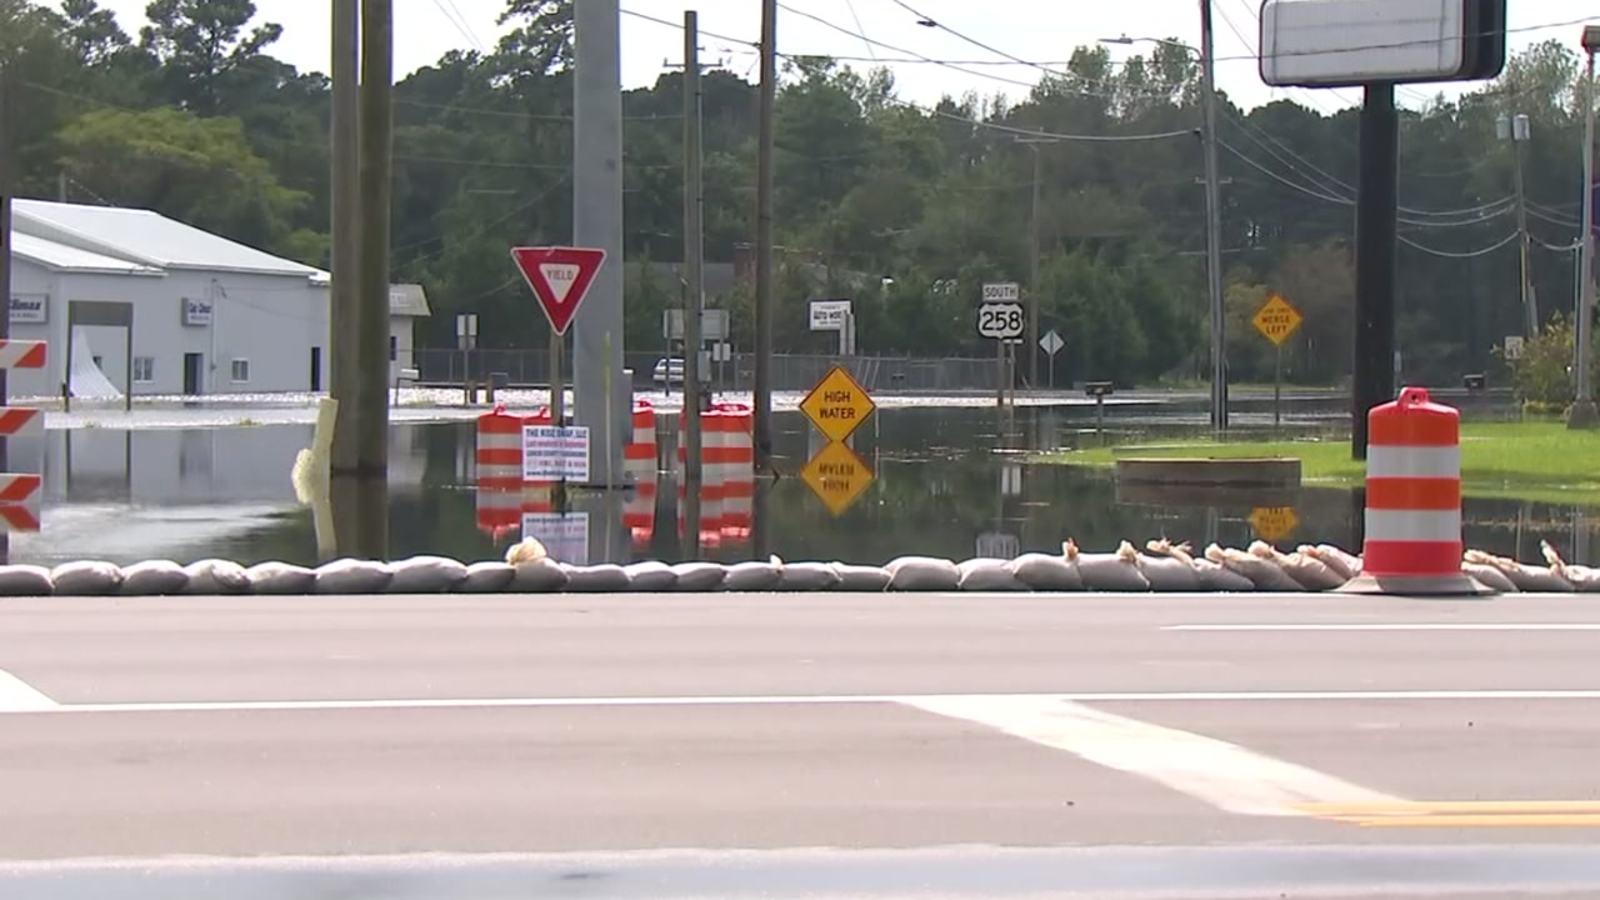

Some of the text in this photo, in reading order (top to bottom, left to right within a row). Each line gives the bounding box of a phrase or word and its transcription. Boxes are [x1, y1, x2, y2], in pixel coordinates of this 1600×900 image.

[547, 269, 574, 281] YIELD
[985, 286, 1017, 297] SOUTH
[982, 311, 1021, 331] 258
[1262, 315, 1290, 324] MERGE
[1266, 325, 1287, 334] LEFT
[824, 390, 851, 403] HIGH
[819, 407, 856, 419] WATER
